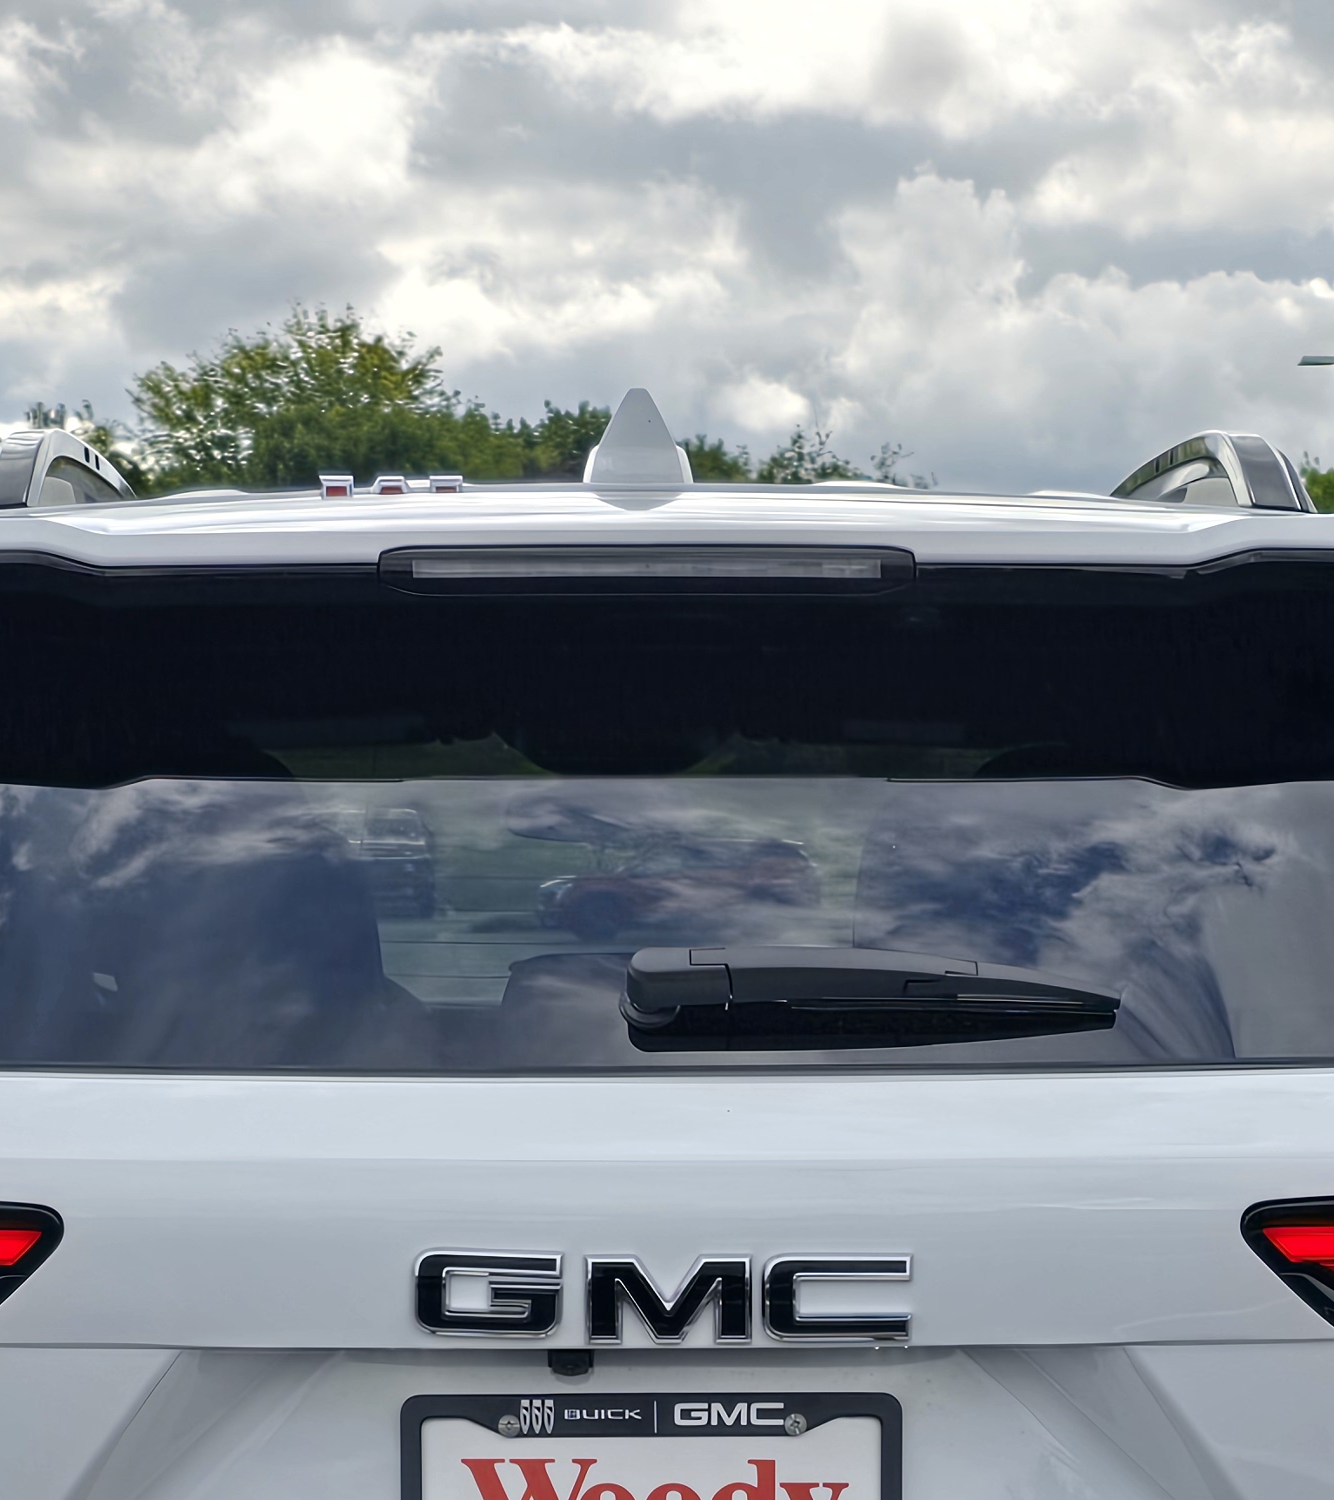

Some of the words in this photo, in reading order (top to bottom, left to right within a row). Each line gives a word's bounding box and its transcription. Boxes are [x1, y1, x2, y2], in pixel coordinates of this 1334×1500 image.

[414, 1247, 914, 1345] GMC
[563, 1408, 643, 1421] BUICK
[673, 1402, 785, 1427] GMC
